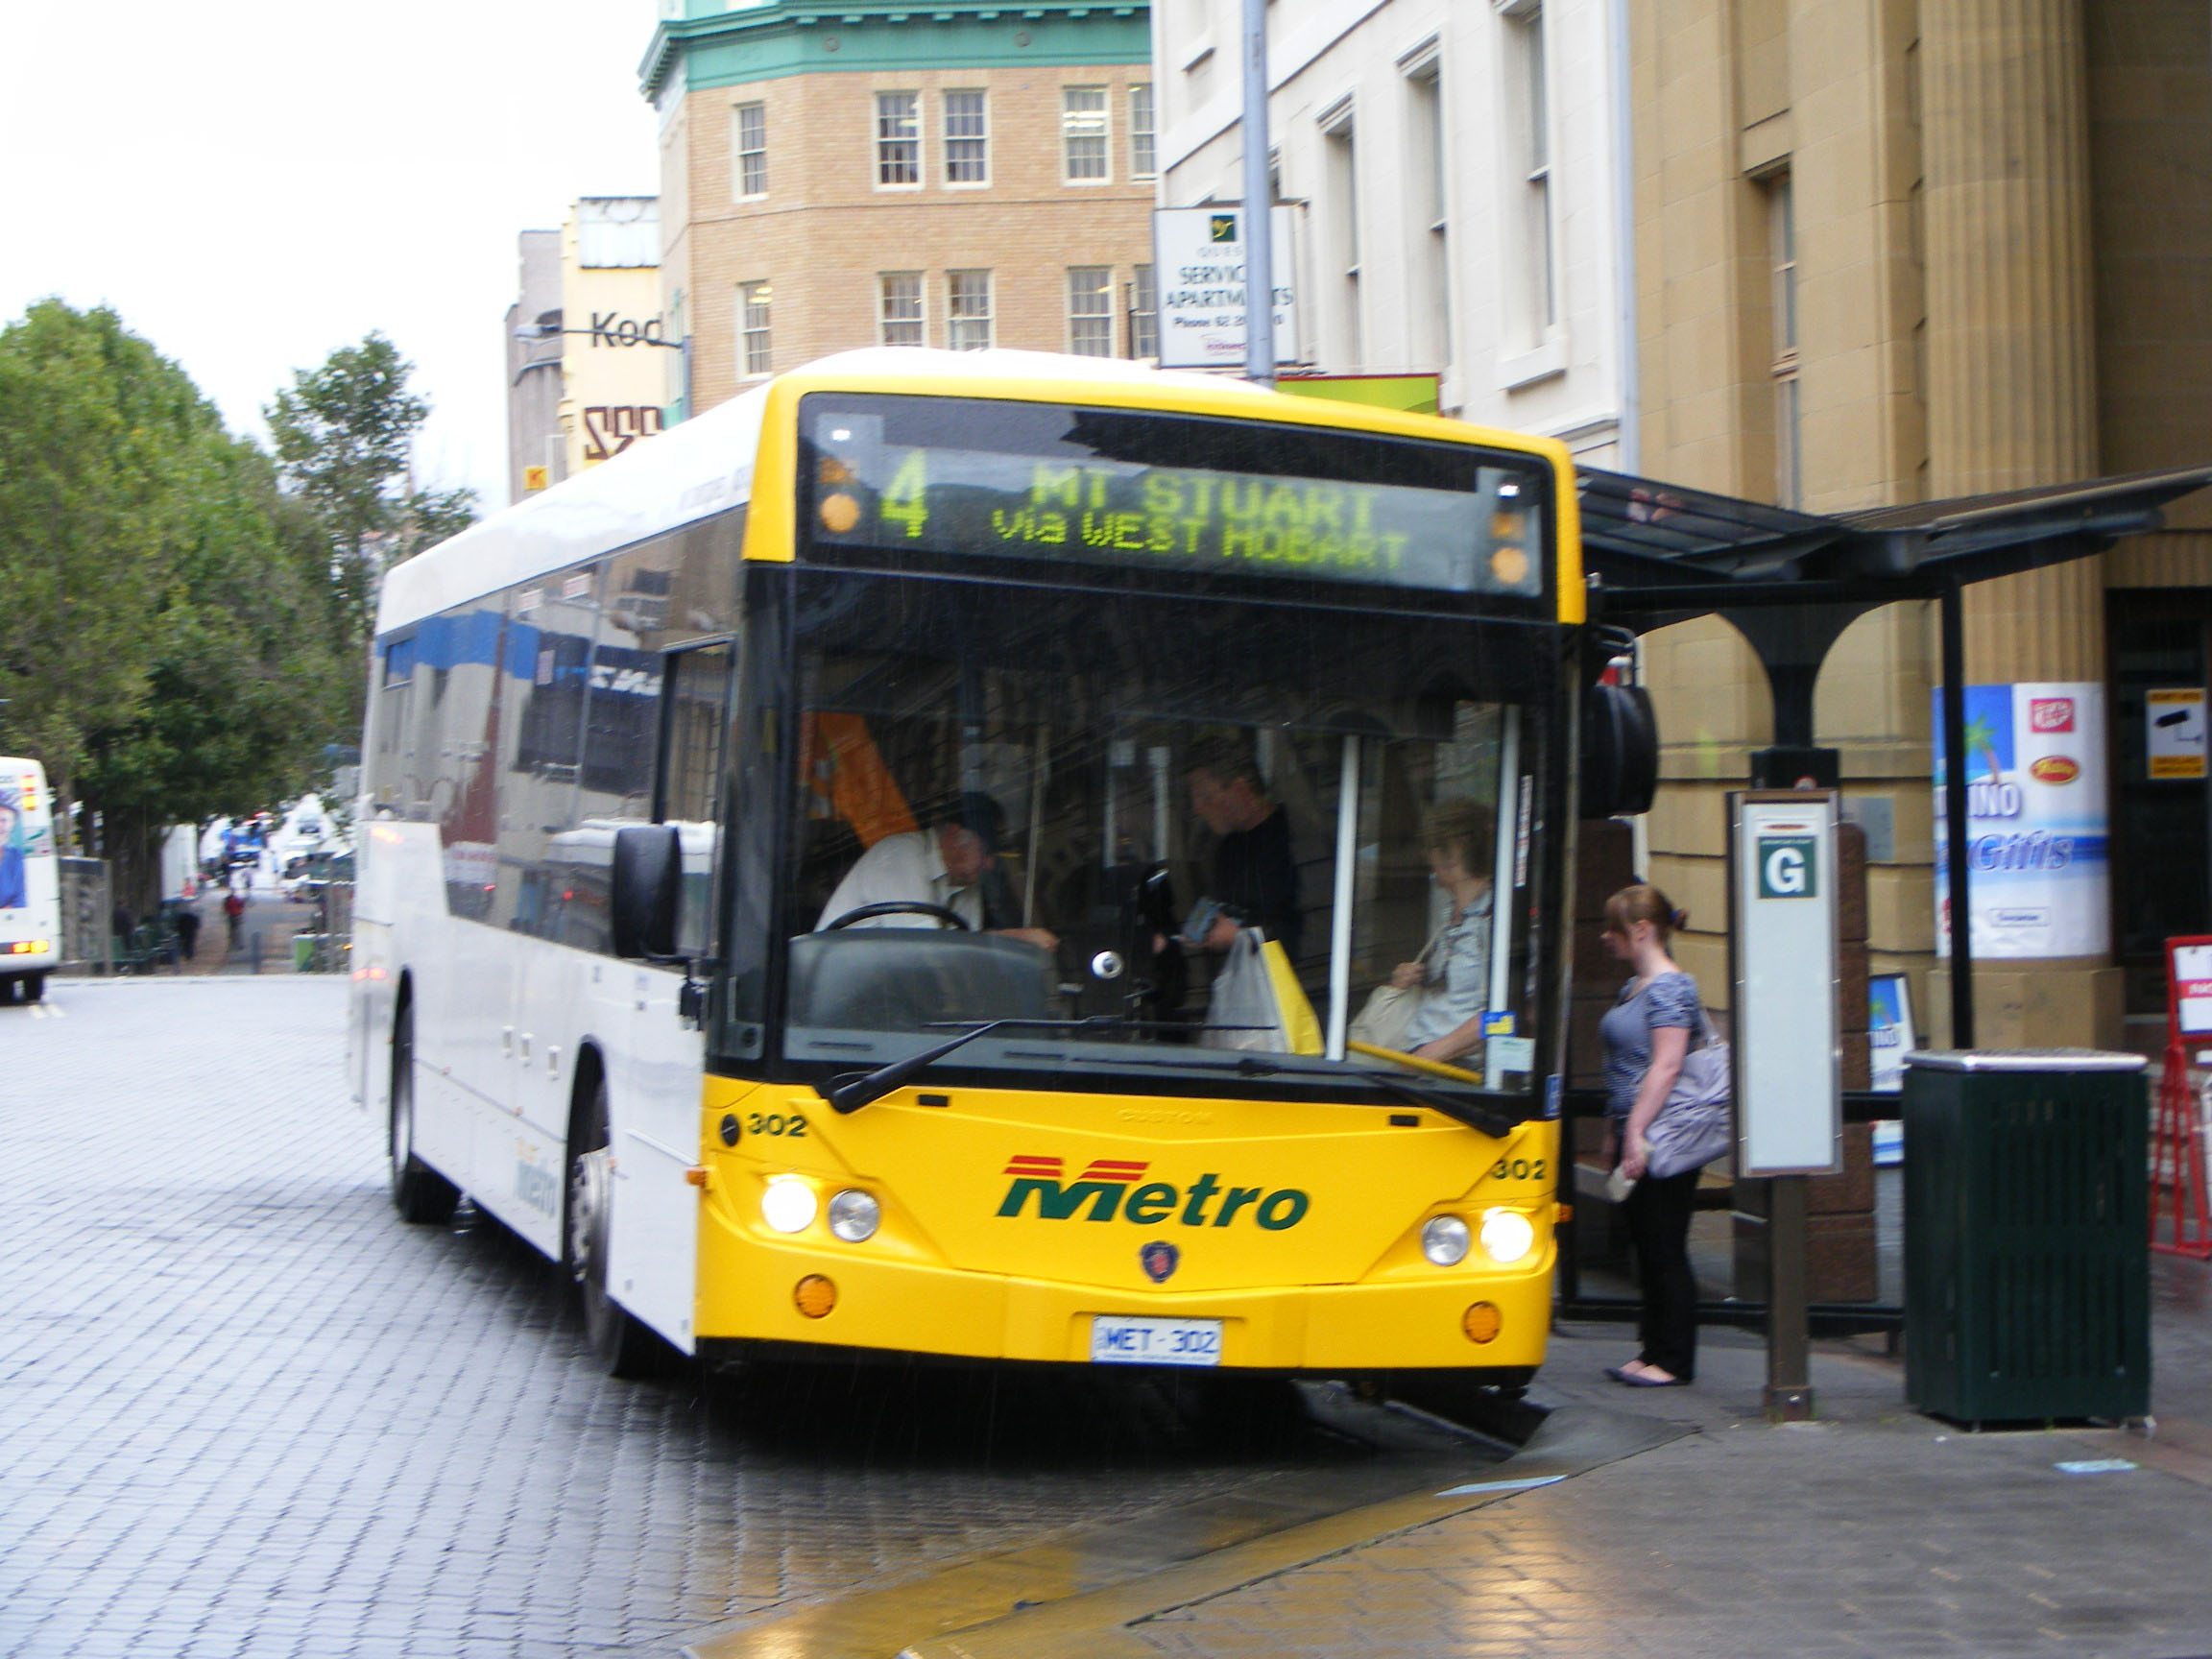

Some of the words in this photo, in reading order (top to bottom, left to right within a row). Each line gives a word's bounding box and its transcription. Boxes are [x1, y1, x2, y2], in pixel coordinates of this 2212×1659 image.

[1166, 287, 1293, 308] APARTMTS
[880, 447, 928, 540] 4
[1032, 462, 1118, 509] MT
[1142, 472, 1381, 531] STUART
[992, 508, 1067, 544] via
[1080, 510, 1207, 554] WEST
[1222, 524, 1409, 571] HOBART
[1765, 847, 1806, 893] G
[747, 1112, 808, 1137] 302
[997, 1156, 1310, 1232] Metro
[1491, 1159, 1546, 1180] 302
